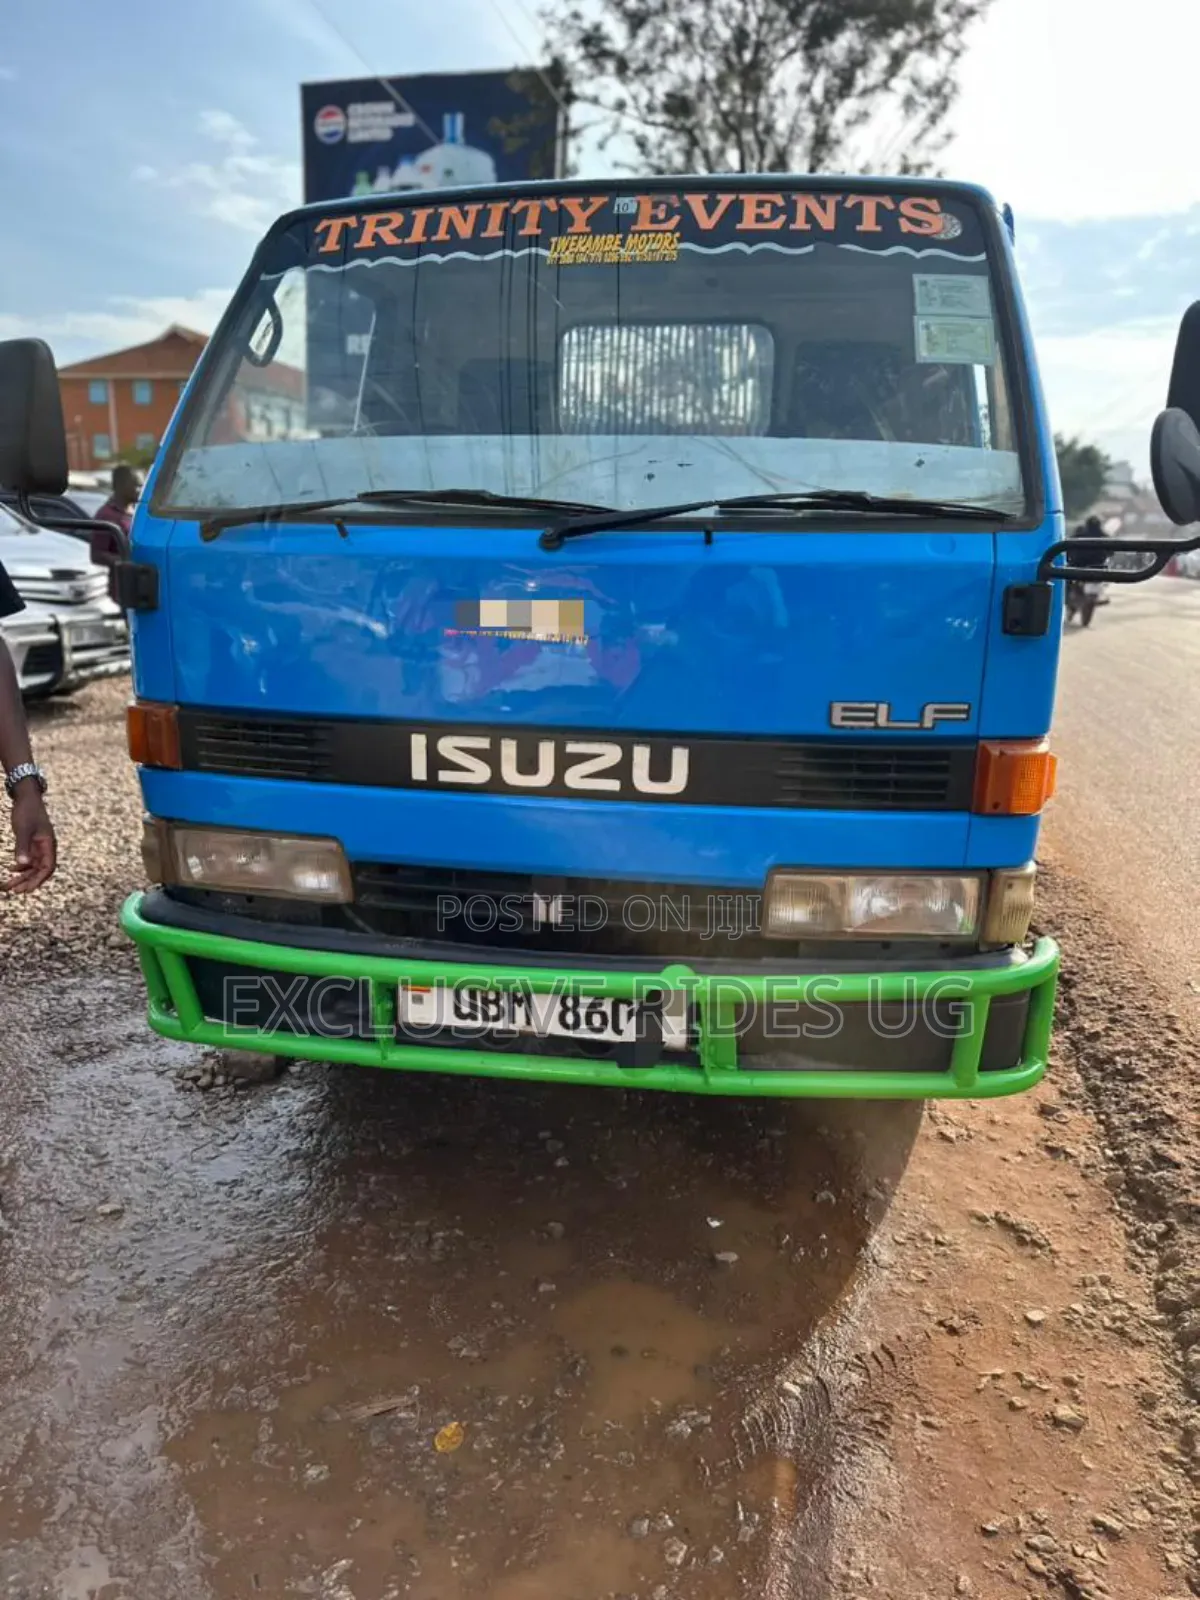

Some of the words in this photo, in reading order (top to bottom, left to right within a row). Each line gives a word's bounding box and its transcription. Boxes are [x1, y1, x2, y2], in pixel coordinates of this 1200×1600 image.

[314, 196, 609, 253] TRINITY
[631, 193, 945, 235] EVENTS
[624, 232, 681, 252] MOTORS
[829, 701, 971, 730] ELF
[410, 733, 690, 795] ISUZU
